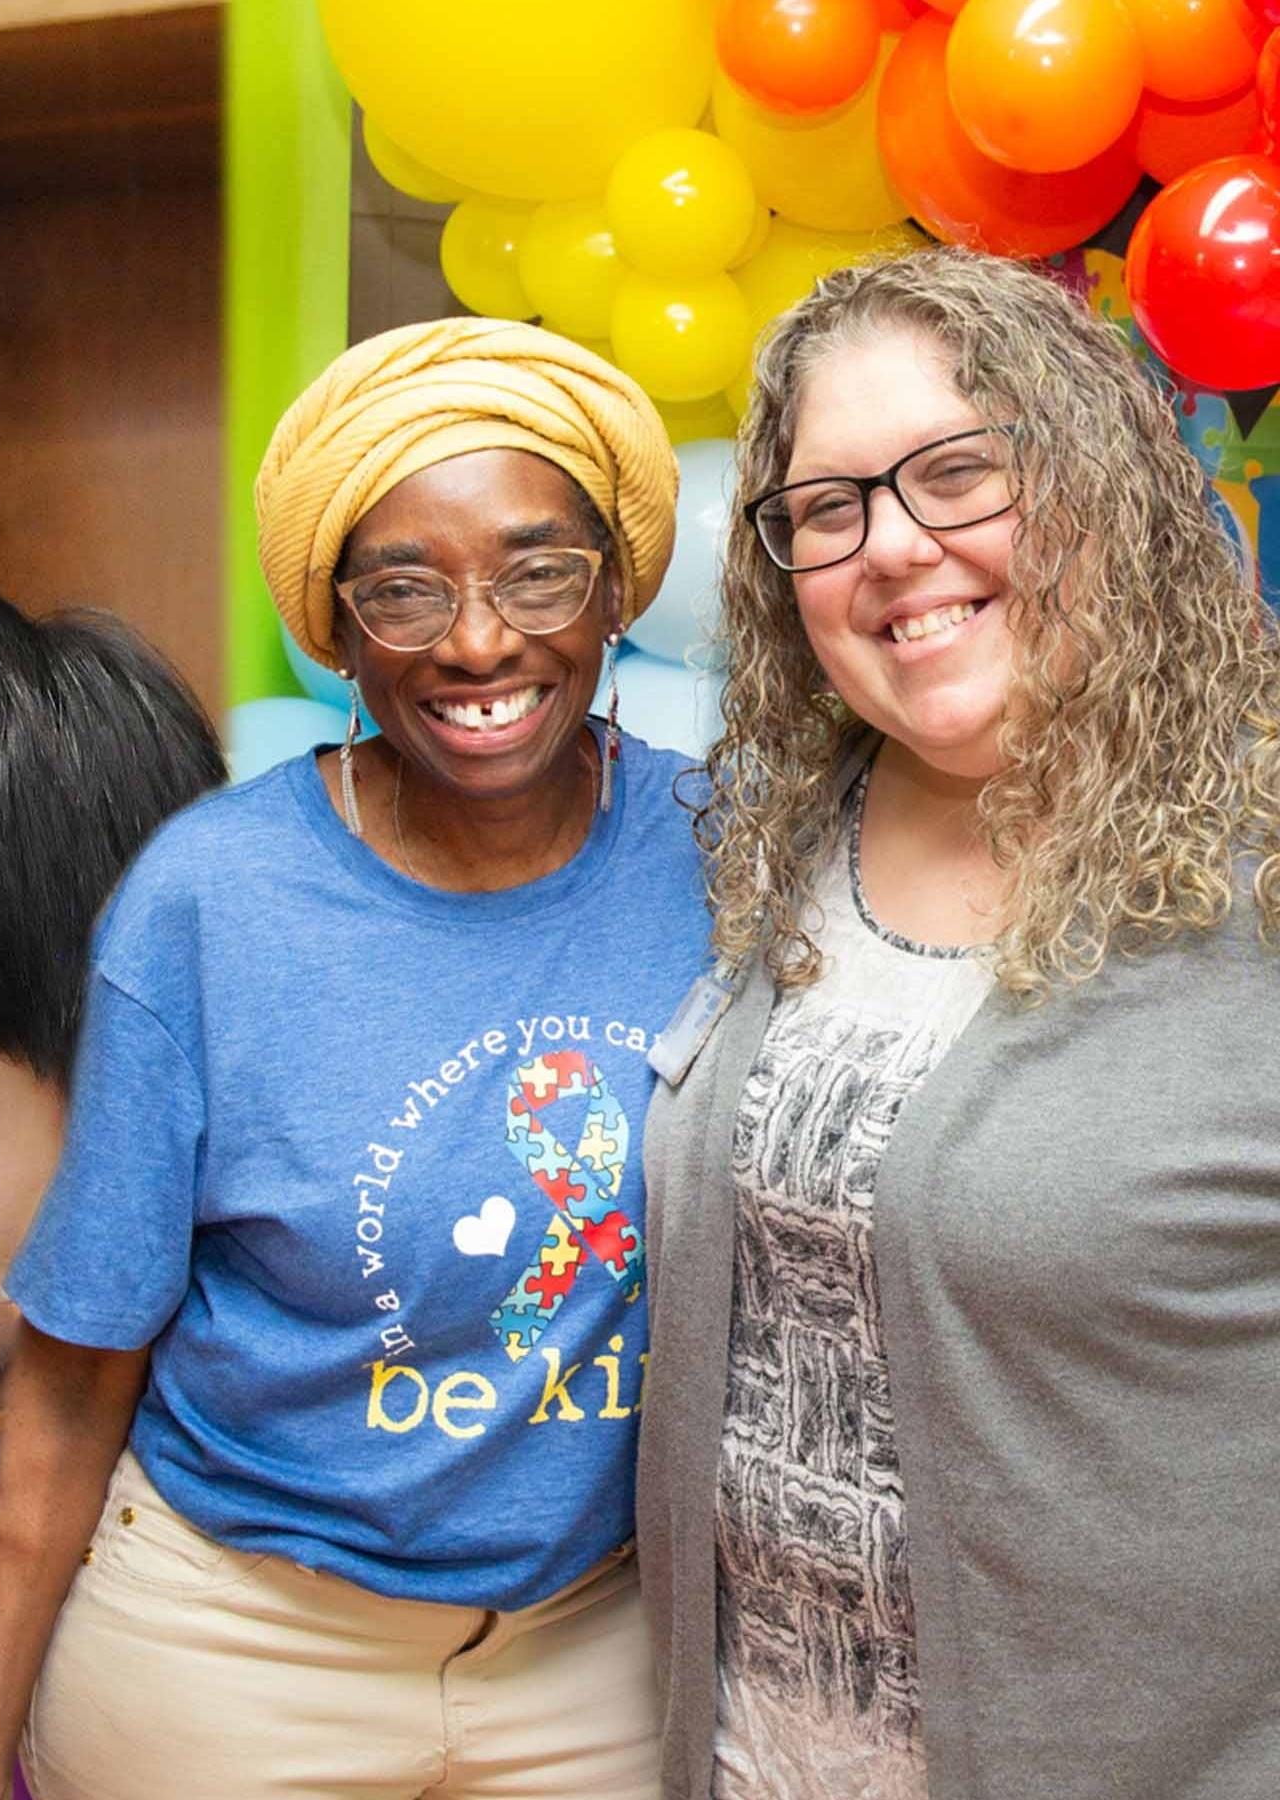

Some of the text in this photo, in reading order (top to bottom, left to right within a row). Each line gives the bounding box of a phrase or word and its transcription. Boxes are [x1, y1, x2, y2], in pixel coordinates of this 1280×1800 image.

[515, 1015, 591, 1056] you
[604, 1020, 662, 1053] ca
[390, 1029, 508, 1132] where
[354, 1142, 404, 1279] world
[375, 1288, 400, 1311] a
[366, 1360, 497, 1439] be
